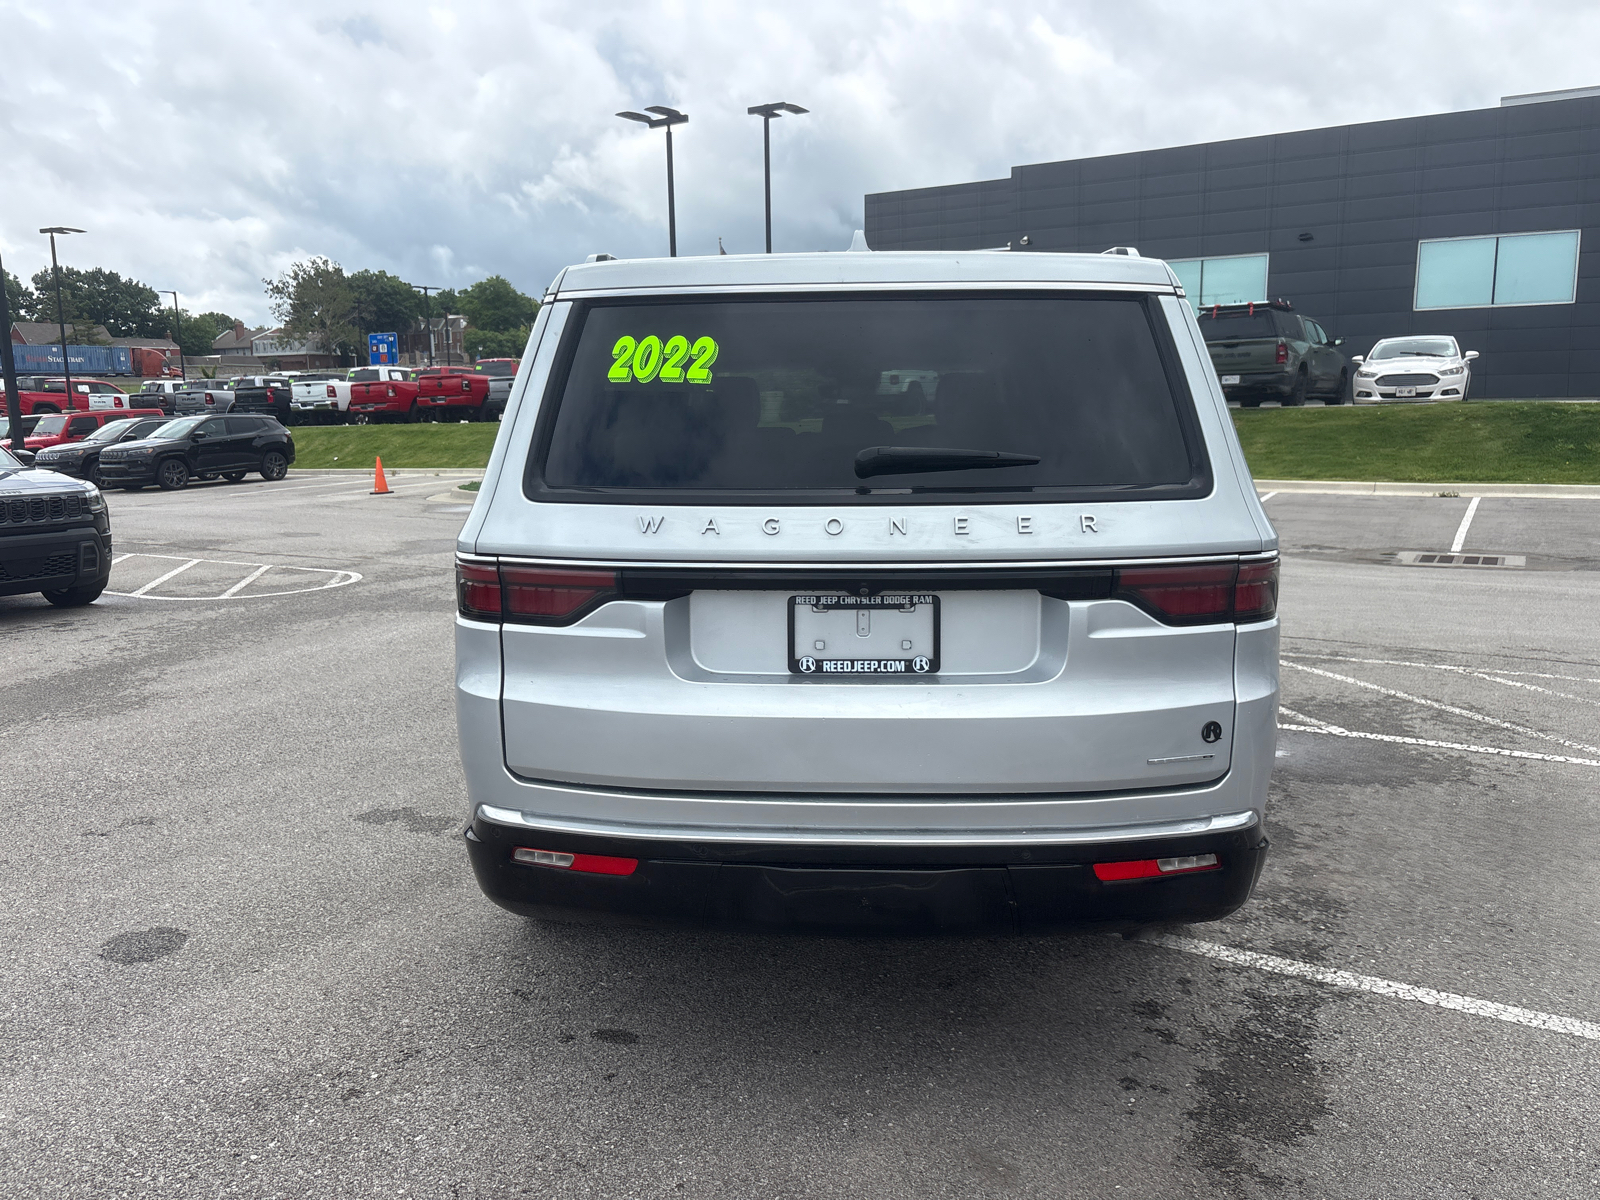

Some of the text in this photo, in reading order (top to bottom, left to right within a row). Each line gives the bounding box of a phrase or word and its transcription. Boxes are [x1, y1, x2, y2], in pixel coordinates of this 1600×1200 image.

[47, 355, 85, 363] STACTRAIN
[607, 335, 719, 385] 2022
[637, 514, 1099, 536] WAGONEER
[795, 595, 933, 605] REED JEEP CHRYSLER DODGE RAM
[822, 660, 906, 673] REEDJEEP.COM
